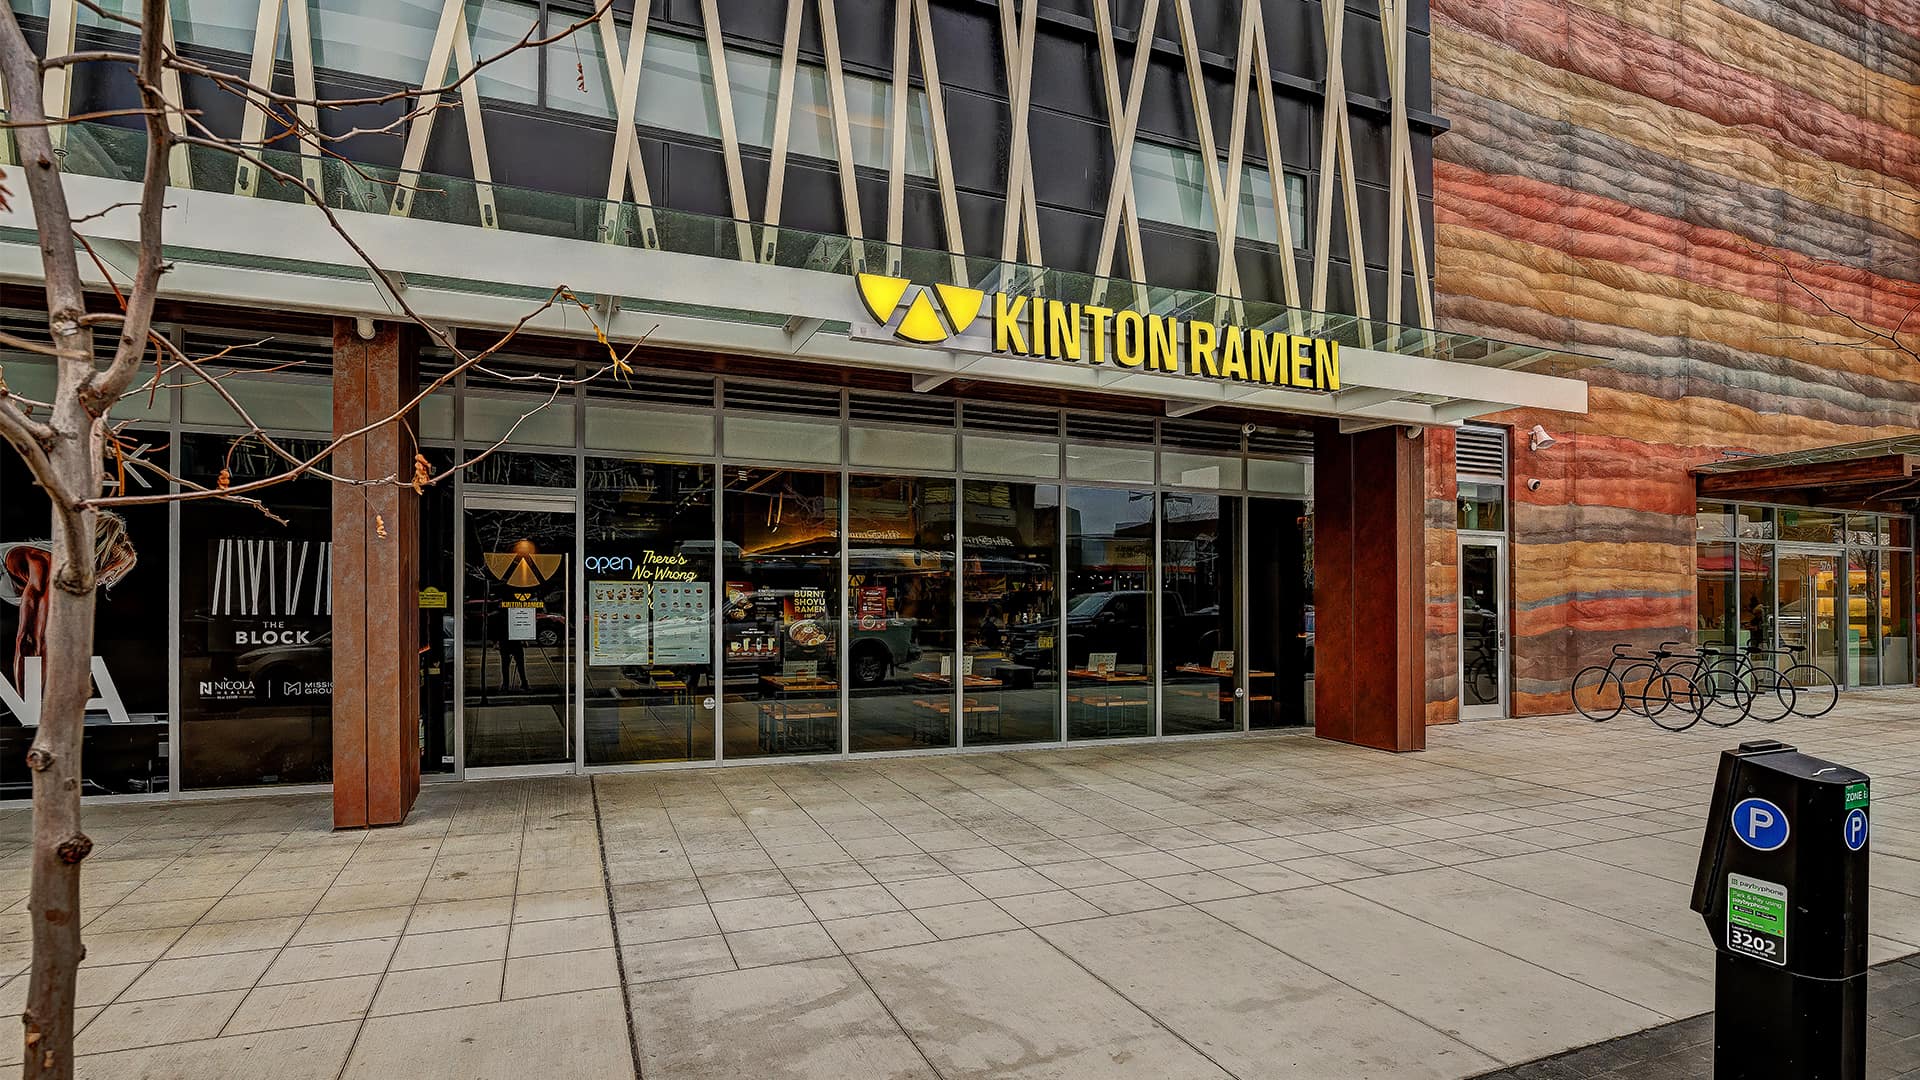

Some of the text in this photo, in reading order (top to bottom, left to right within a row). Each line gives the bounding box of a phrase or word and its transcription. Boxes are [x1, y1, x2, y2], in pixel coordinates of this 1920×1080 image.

[994, 292, 1340, 391] KINTON RAMEN
[585, 556, 633, 574] open
[643, 550, 688, 565] There's
[632, 565, 698, 583] No Wrong
[794, 590, 825, 598] BURNT
[794, 598, 826, 606] SHOYU
[794, 605, 826, 613] RAMEN
[262, 621, 285, 629] THE
[235, 630, 311, 645] BLOCK
[1846, 790, 1863, 802] ZONE
[1749, 806, 1774, 839] P
[1851, 816, 1862, 843] P
[1740, 881, 1784, 897] paybyphone
[1732, 930, 1777, 956] 3202
